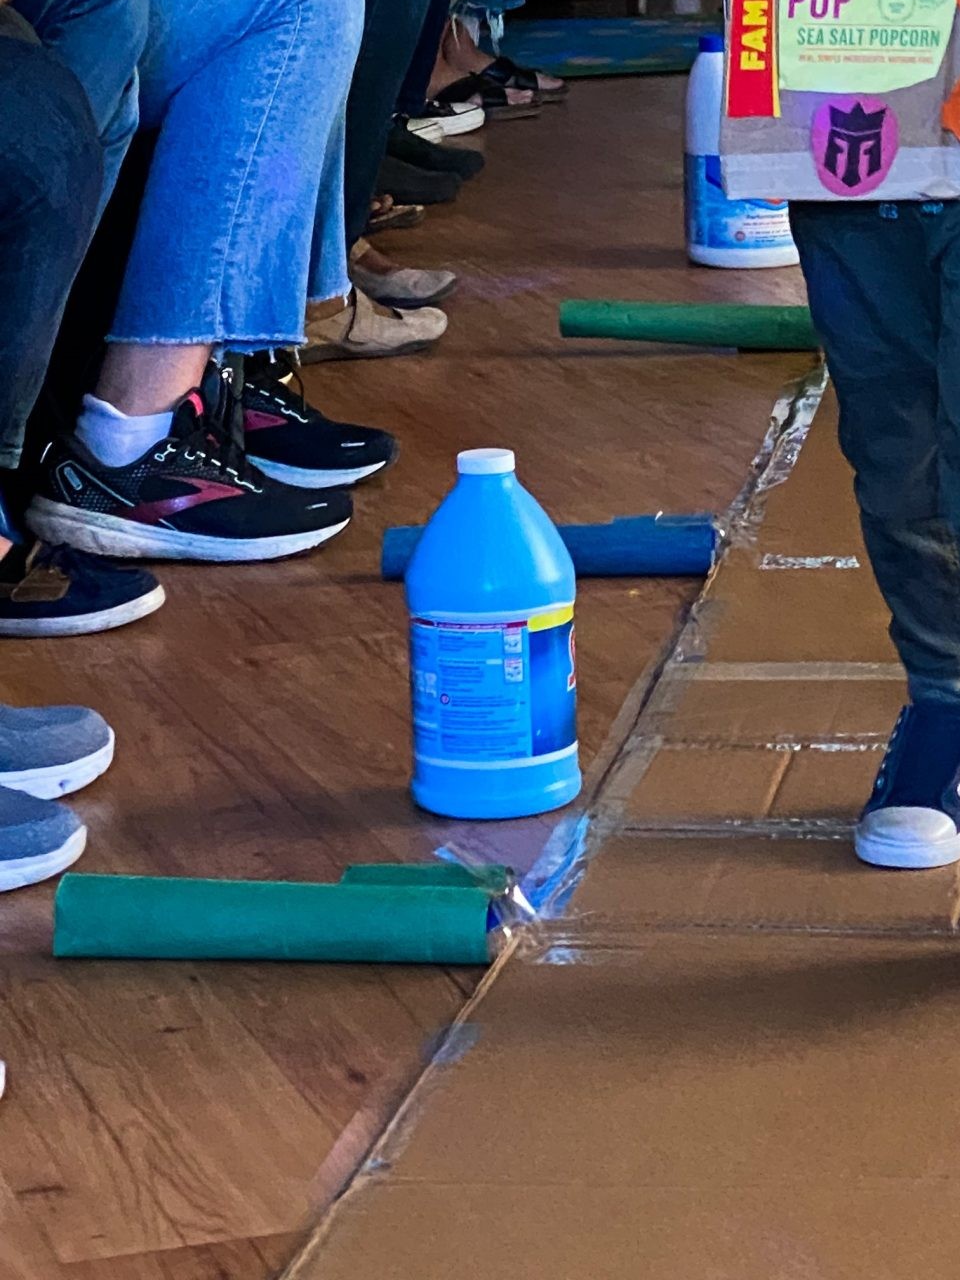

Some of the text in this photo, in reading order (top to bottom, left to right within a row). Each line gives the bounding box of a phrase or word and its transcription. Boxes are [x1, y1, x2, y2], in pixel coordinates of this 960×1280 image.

[797, 28, 941, 47] SEA SALT POPCORN
